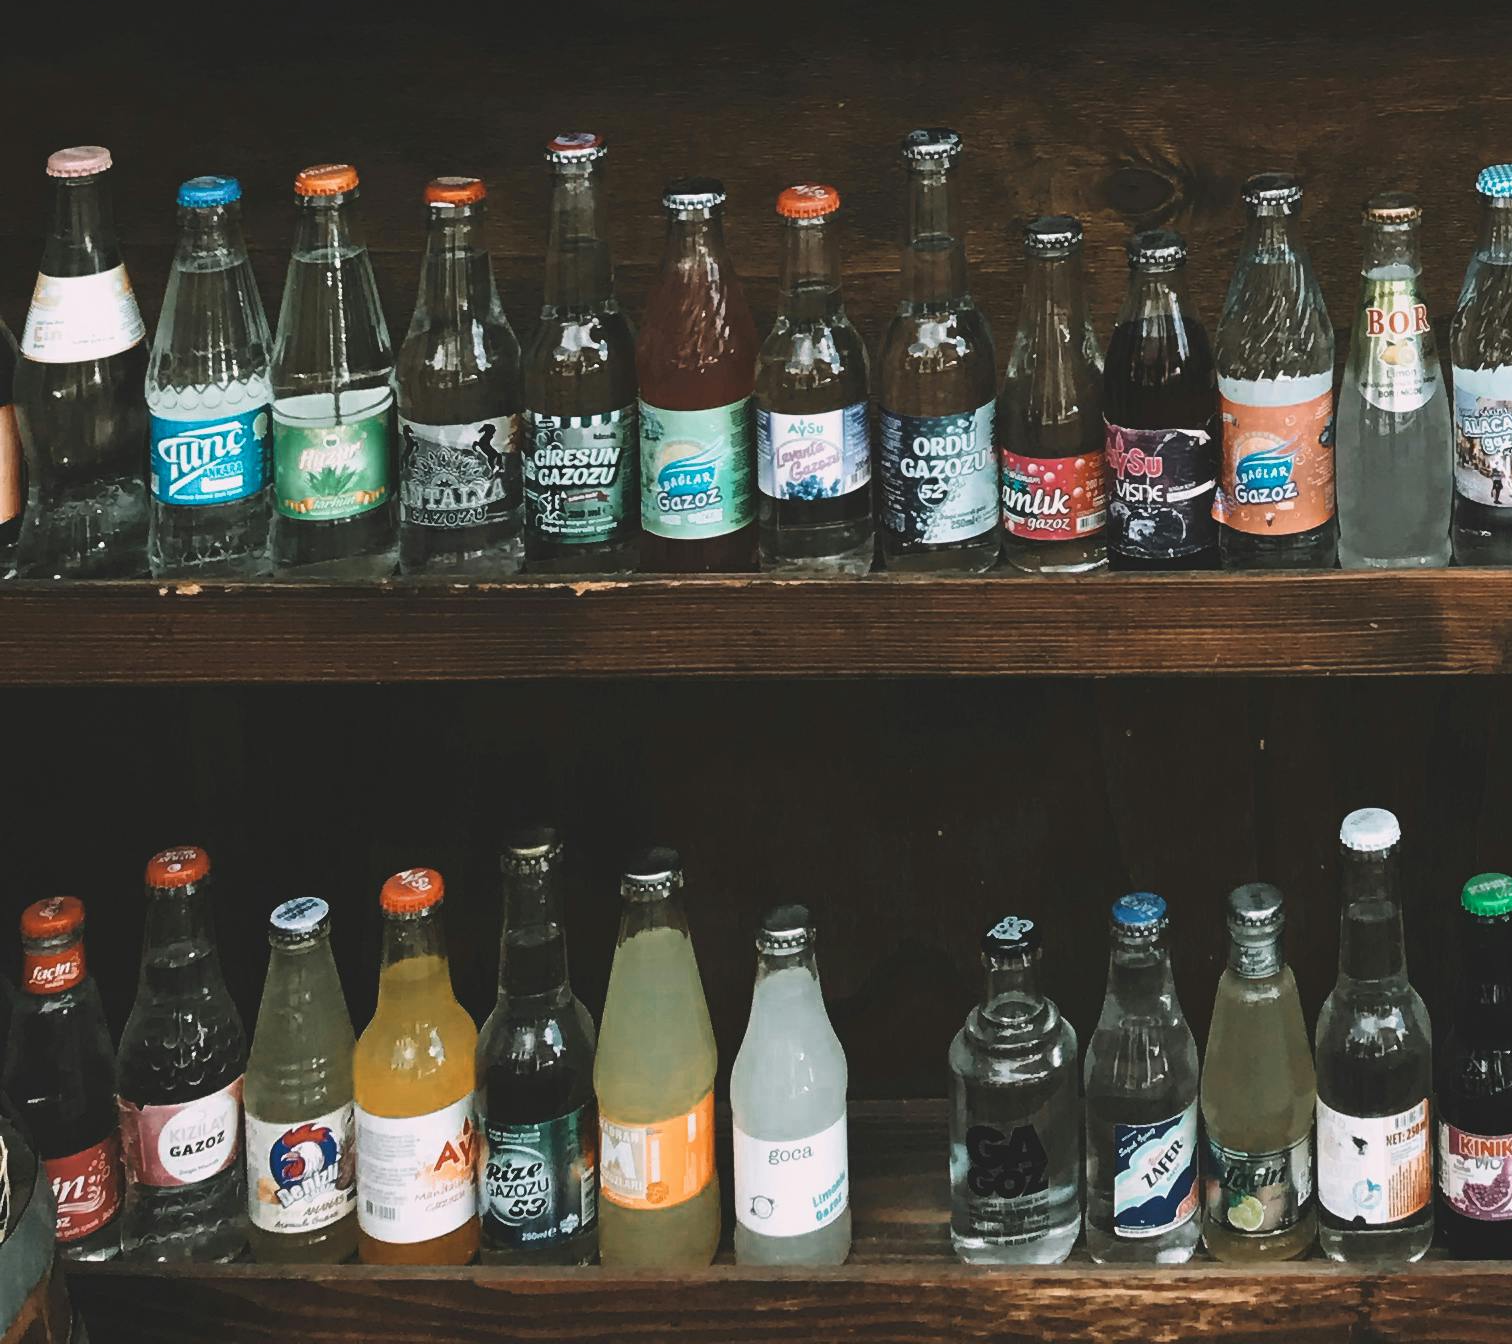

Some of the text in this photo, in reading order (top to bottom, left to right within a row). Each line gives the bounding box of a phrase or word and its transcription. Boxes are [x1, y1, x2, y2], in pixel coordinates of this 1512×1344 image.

[1365, 303, 1430, 337] BOR
[913, 431, 976, 457] ORDU
[533, 447, 622, 468] GİRESUN
[900, 449, 989, 478] GAZOZU
[537, 466, 616, 487] GAZOZU
[664, 470, 712, 492] BAĞLAR
[1241, 465, 1290, 486] BAĞLAR
[919, 483, 944, 500] 52
[411, 507, 489, 530] GAZOZU
[1027, 514, 1072, 532] gazoz
[170, 1130, 227, 1159] GAZOZ
[768, 1145, 814, 1168] goca
[1142, 1139, 1185, 1189] ZAFER
[485, 1162, 543, 1185] Rize
[486, 1177, 551, 1202] GAZOZU
[508, 1197, 548, 1218] 53
